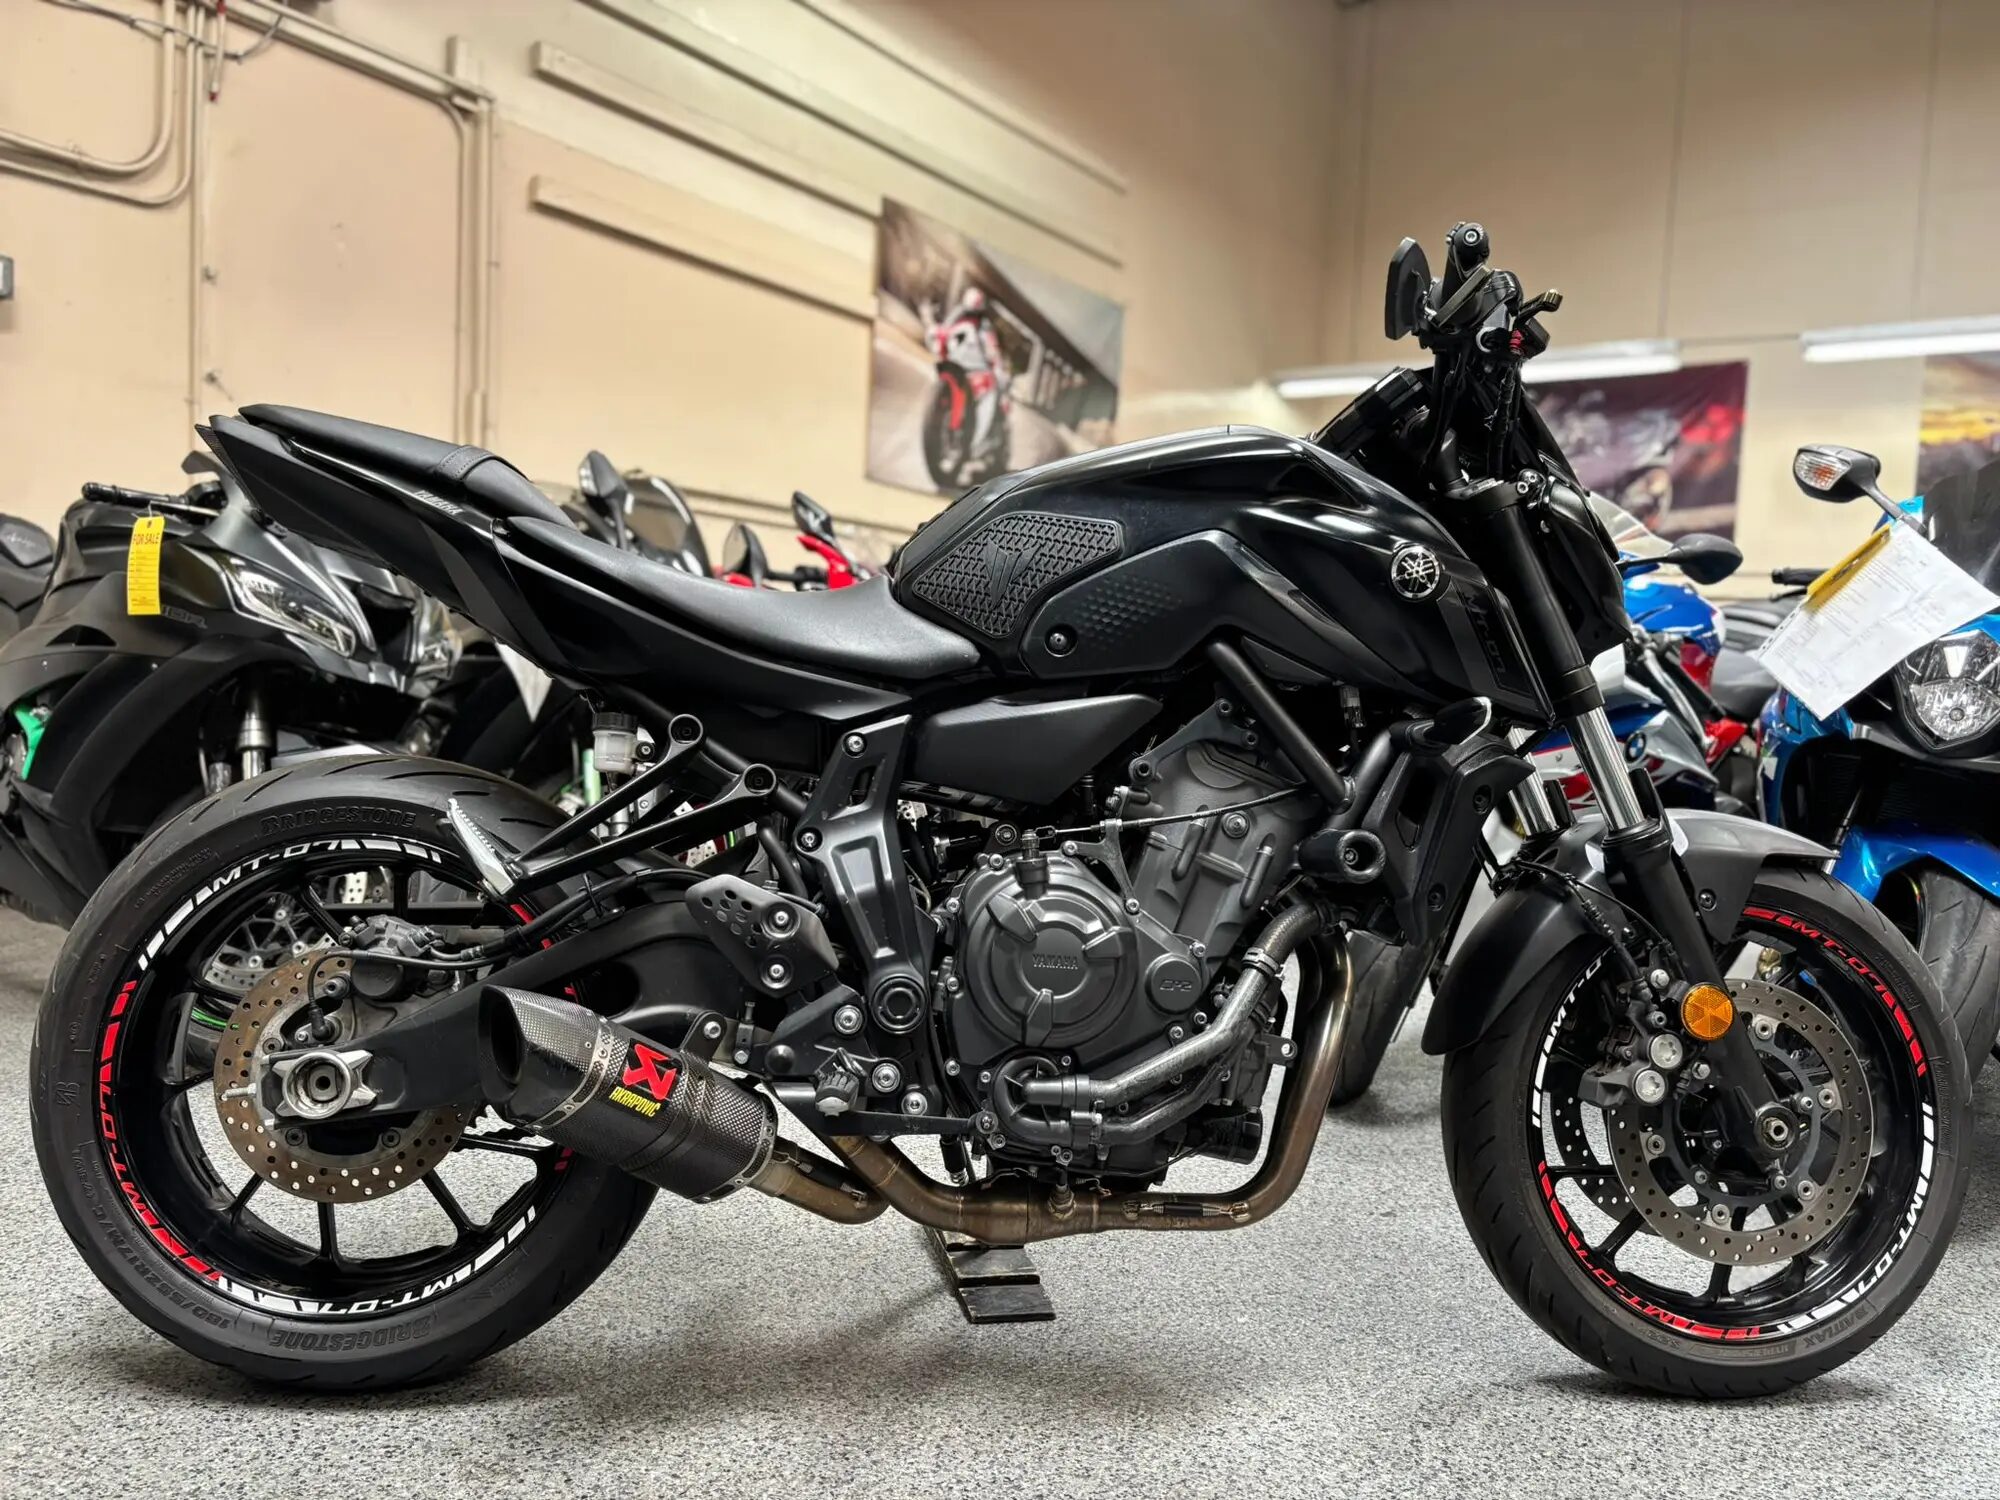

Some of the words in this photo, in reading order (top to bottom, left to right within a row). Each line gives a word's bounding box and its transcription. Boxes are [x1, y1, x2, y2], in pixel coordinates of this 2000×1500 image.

[414, 490, 463, 515] YAMAHA
[133, 534, 144, 545] FOR
[145, 533, 160, 544] SALE
[260, 805, 416, 836] BRIDGESTONE
[213, 839, 340, 892] MT-07
[1032, 953, 1079, 970] YAMAHA
[1792, 921, 1887, 993] MT-07
[99, 1082, 148, 1214] MT-07
[1858, 1191, 1923, 1295] MT-07
[318, 1274, 455, 1315] MT-07
[1574, 1249, 1674, 1324] MT-07
[268, 1313, 433, 1351] BRIDGESTONE
